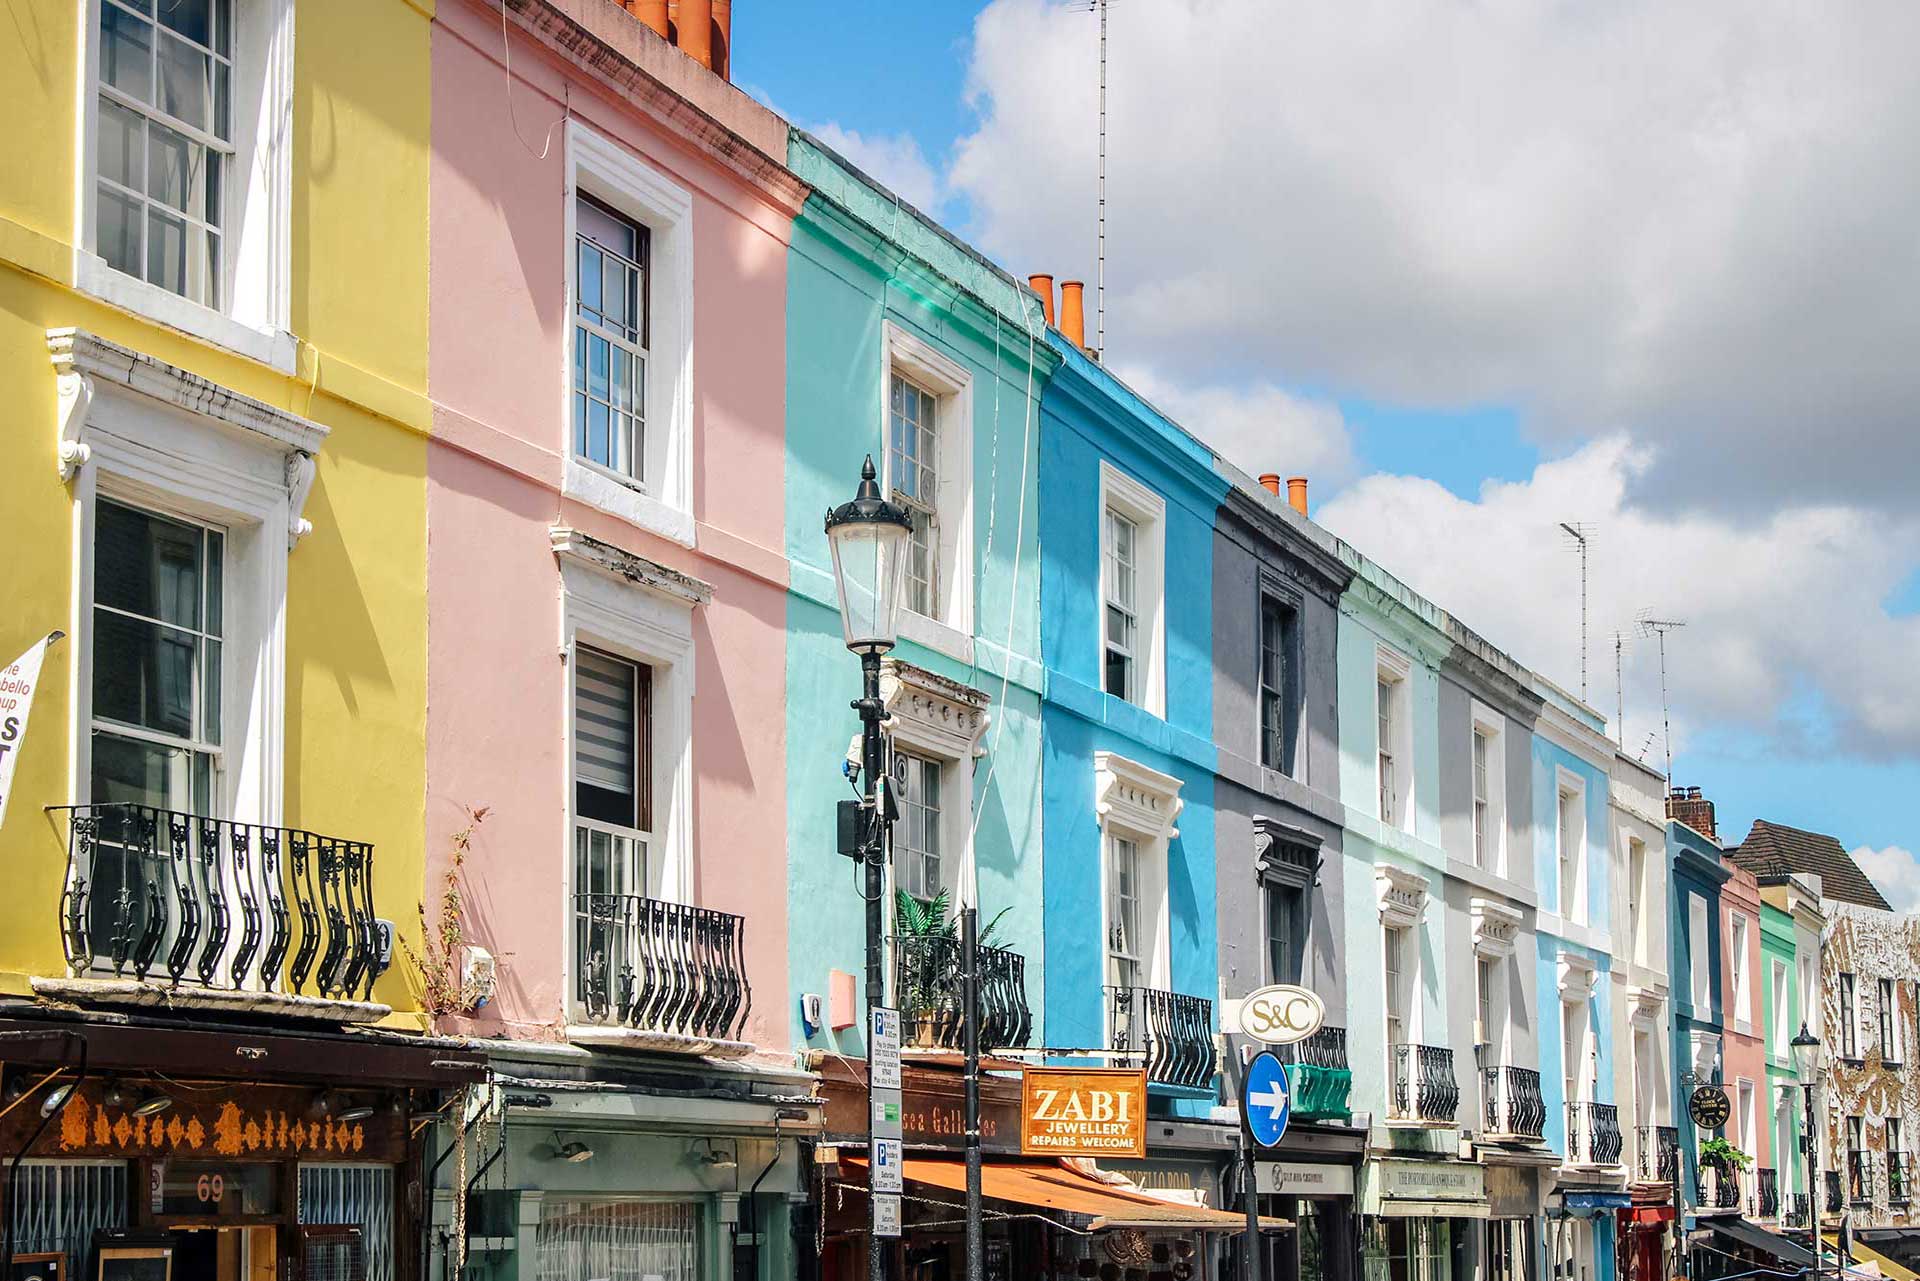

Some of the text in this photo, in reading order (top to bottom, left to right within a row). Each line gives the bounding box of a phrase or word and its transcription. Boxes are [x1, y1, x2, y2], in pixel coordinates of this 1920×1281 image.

[0, 678, 30, 695] bello
[0, 698, 16, 712] up
[1252, 998, 1310, 1033] S&C
[1032, 1089, 1131, 1122] ZABI
[932, 1106, 997, 1137] Galles
[1046, 1122, 1129, 1136] JEWELLERY
[1031, 1136, 1135, 1148] REPAIRS WELCOME
[197, 1174, 224, 1202] 69
[1167, 1171, 1191, 1188] ROAD
